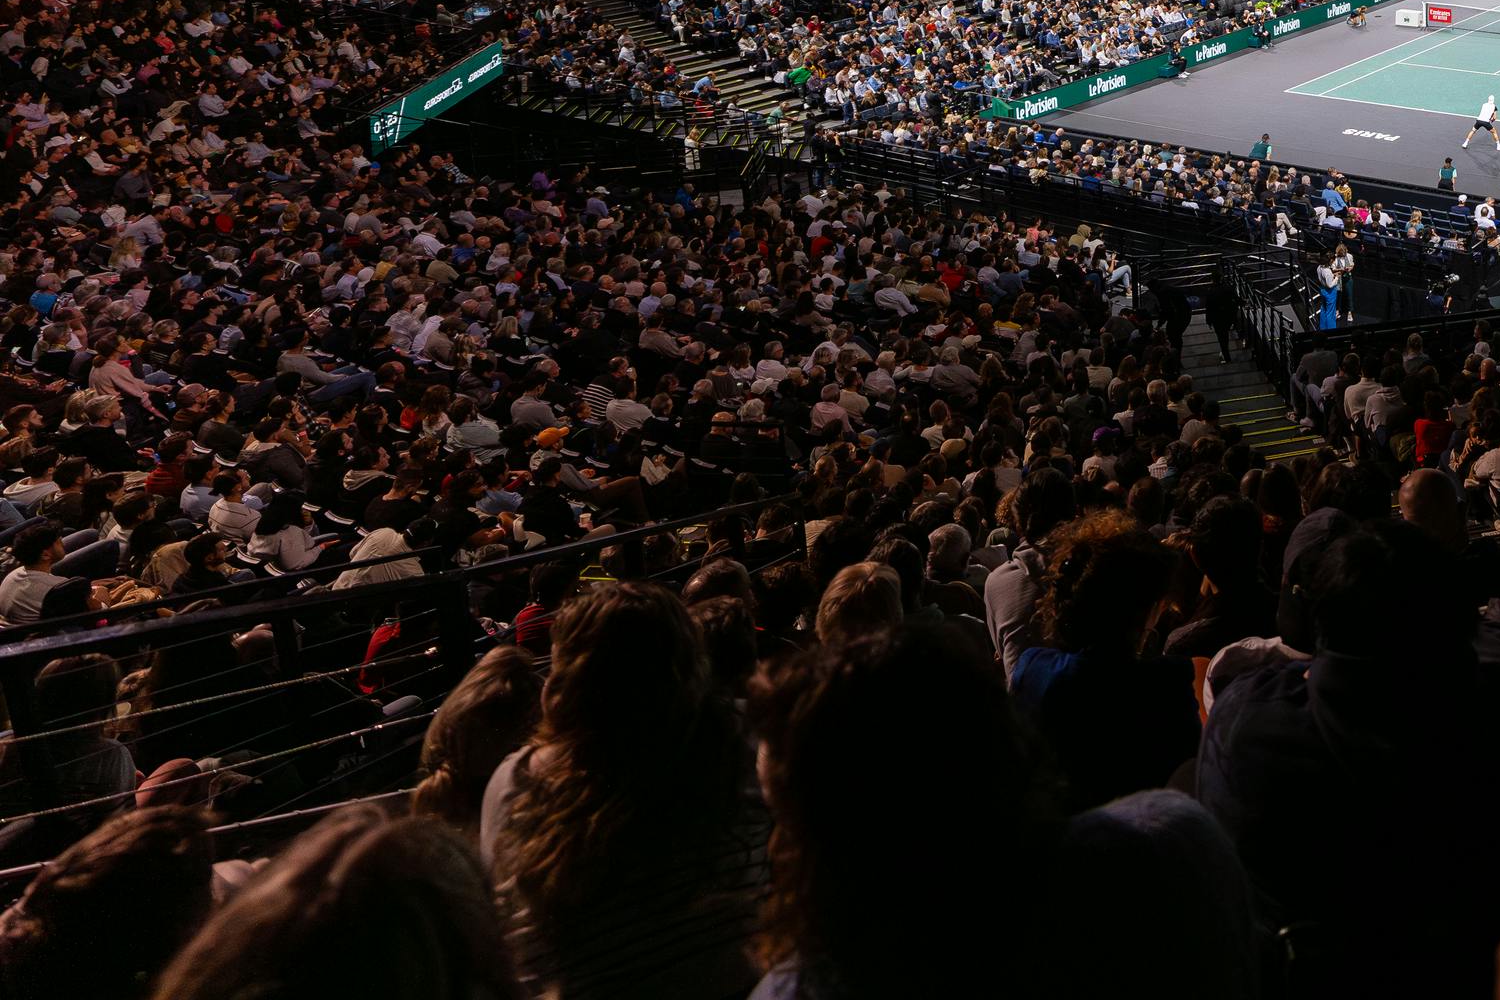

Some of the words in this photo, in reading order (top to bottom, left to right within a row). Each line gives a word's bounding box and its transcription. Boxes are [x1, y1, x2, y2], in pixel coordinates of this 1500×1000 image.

[1327, 8, 1333, 19] Le
[1332, 1, 1351, 16] Parisien
[1273, 25, 1280, 36] Le
[1279, 16, 1301, 34] Parisien
[1195, 49, 1203, 62] Le
[1202, 41, 1227, 60] Parisien
[1088, 83, 1097, 97] Le
[1096, 73, 1126, 94] Parisien
[1016, 107, 1025, 120] Le
[1024, 96, 1058, 118] Parisien
[1341, 128, 1401, 142] PARIS
